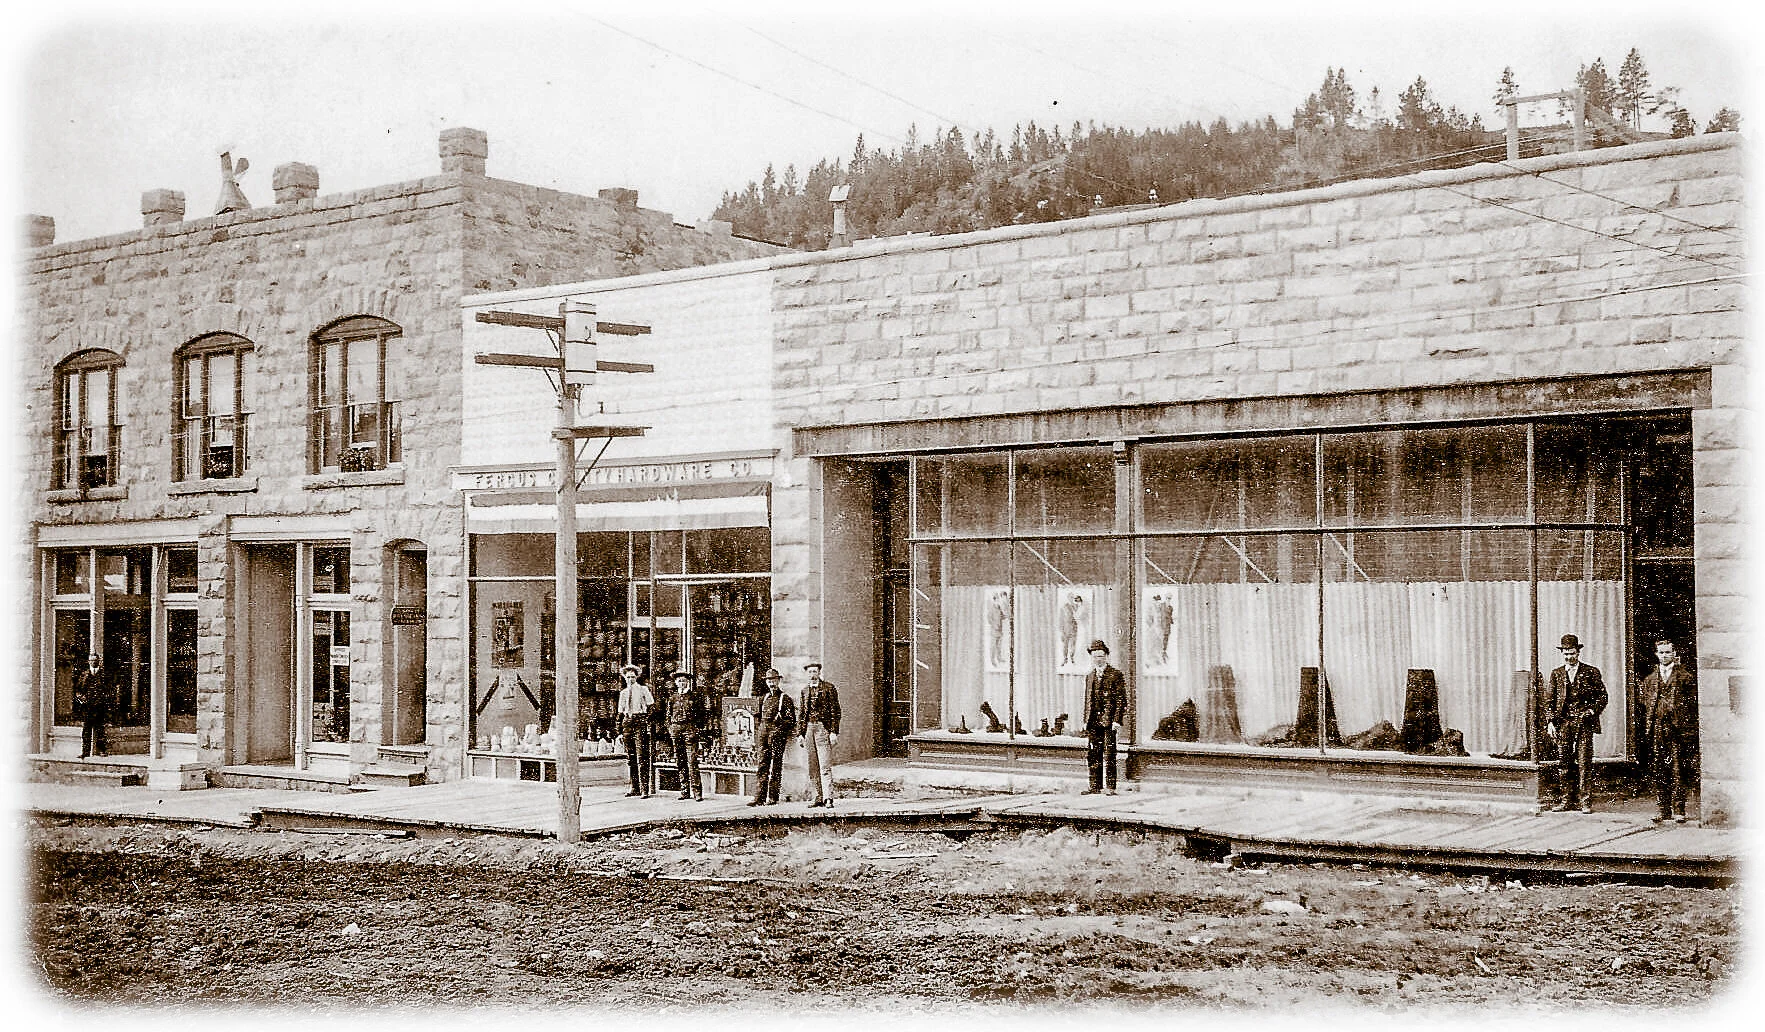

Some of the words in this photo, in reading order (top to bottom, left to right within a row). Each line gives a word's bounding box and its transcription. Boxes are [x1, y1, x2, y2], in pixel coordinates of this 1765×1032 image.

[475, 471, 536, 489] FERGUS
[547, 467, 612, 486] CTY
[618, 462, 712, 484] HARDWARE
